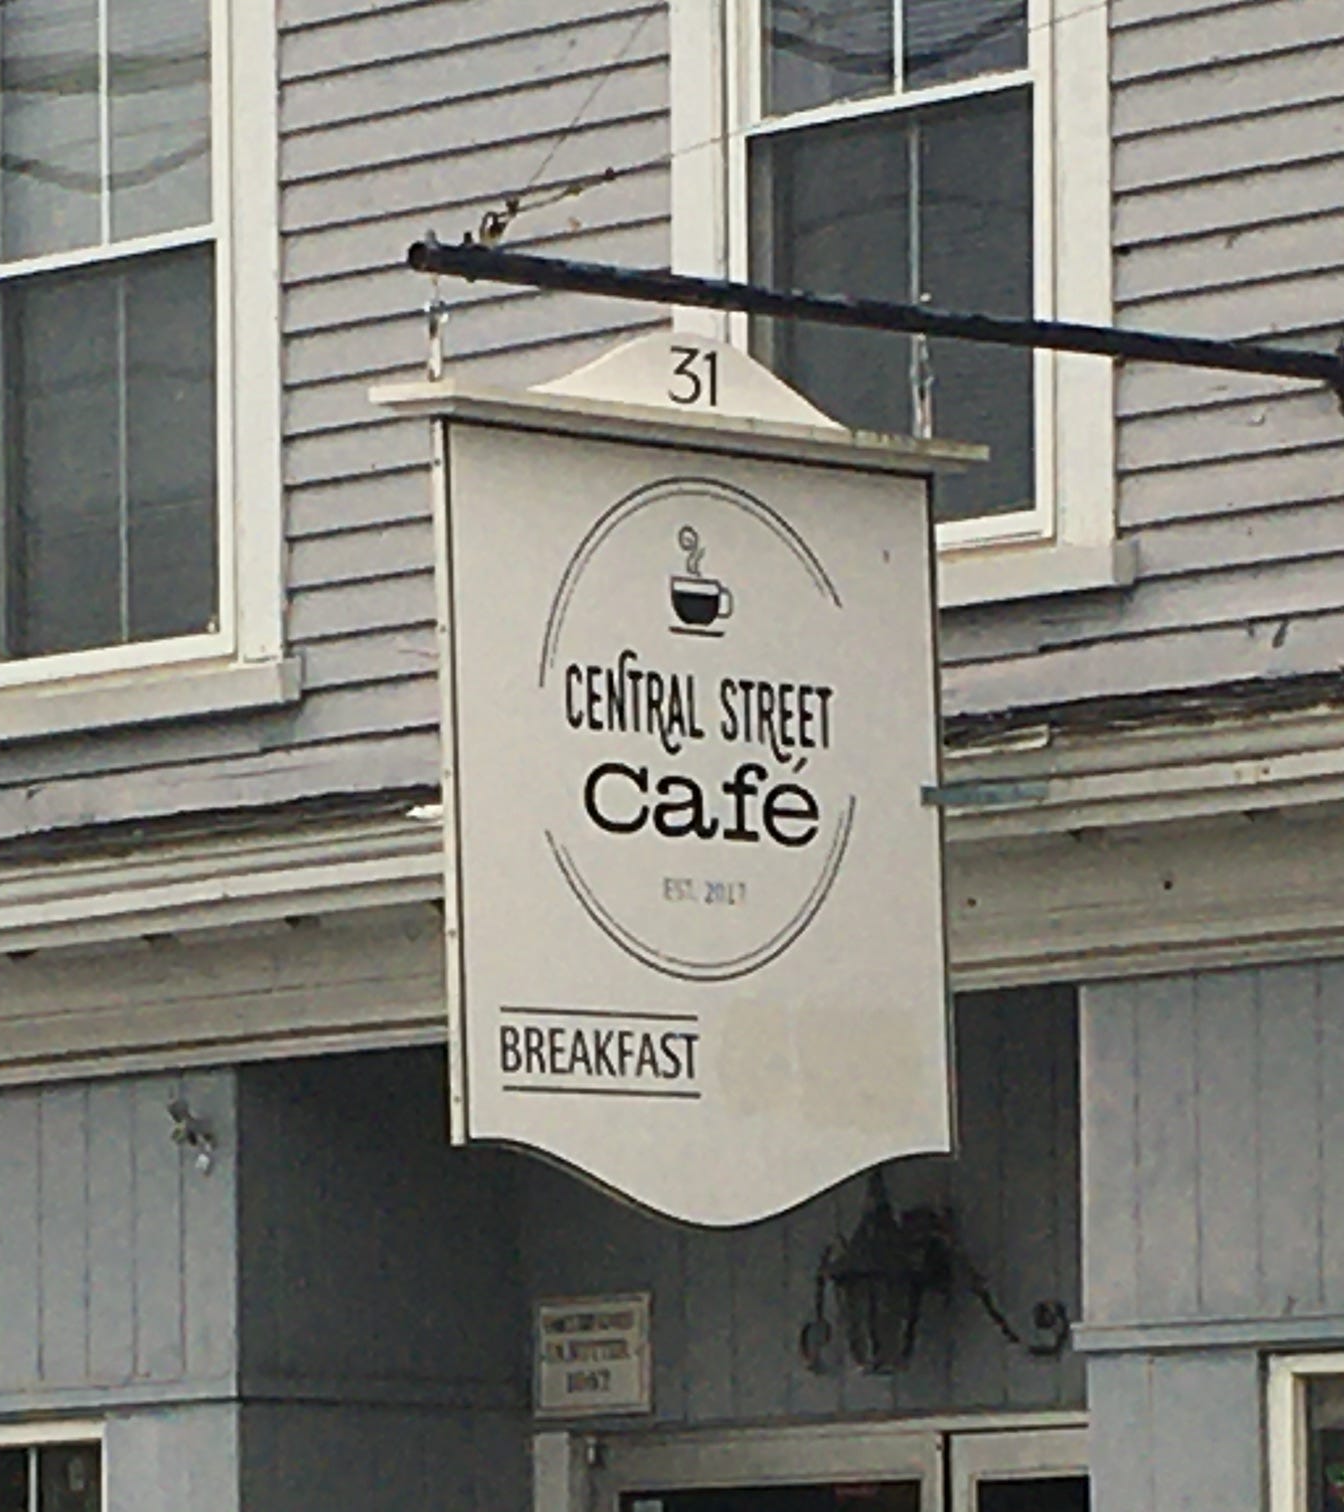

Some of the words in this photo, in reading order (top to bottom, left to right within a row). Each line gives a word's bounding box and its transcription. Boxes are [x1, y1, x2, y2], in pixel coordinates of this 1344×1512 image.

[668, 345, 717, 407] 31
[565, 650, 705, 755] CENTRAL
[720, 677, 833, 763] STREET
[500, 1025, 700, 1080] BREAKFAST
